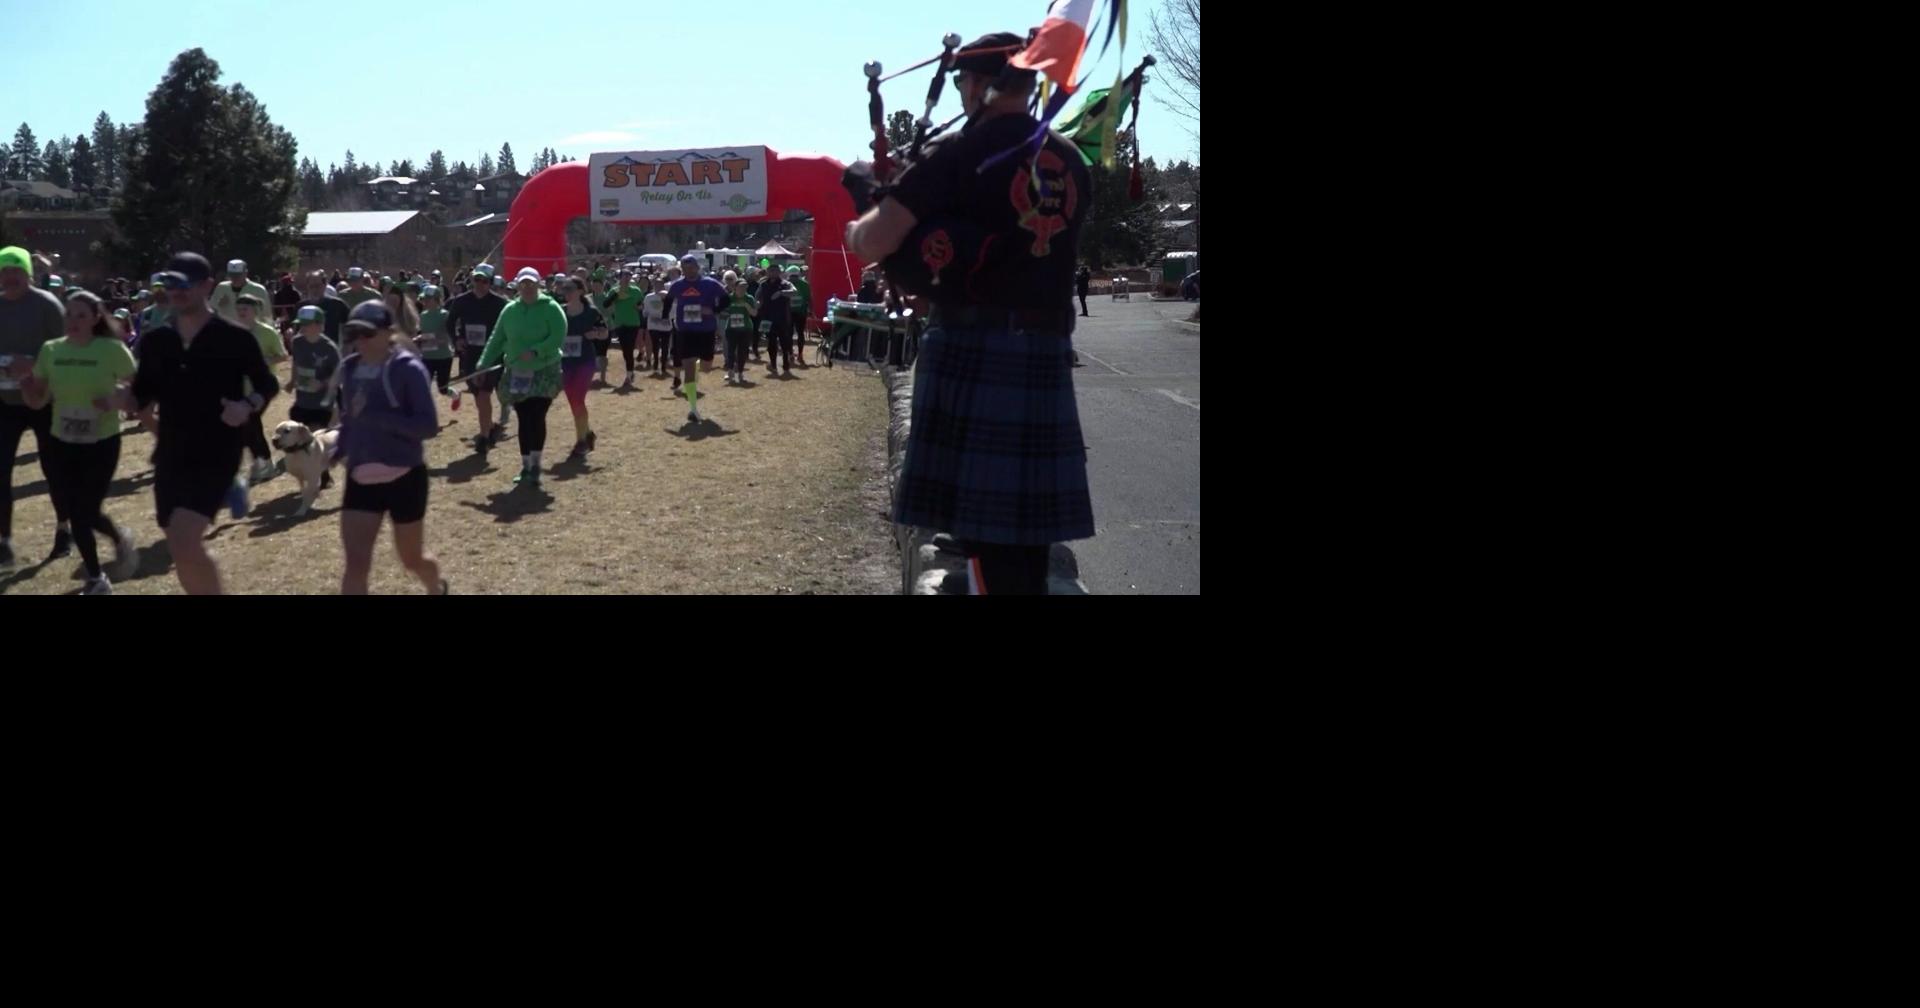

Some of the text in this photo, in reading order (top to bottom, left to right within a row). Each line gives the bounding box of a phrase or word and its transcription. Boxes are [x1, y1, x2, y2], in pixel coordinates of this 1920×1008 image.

[603, 158, 750, 188] START
[640, 189, 712, 204] Relay On Us
